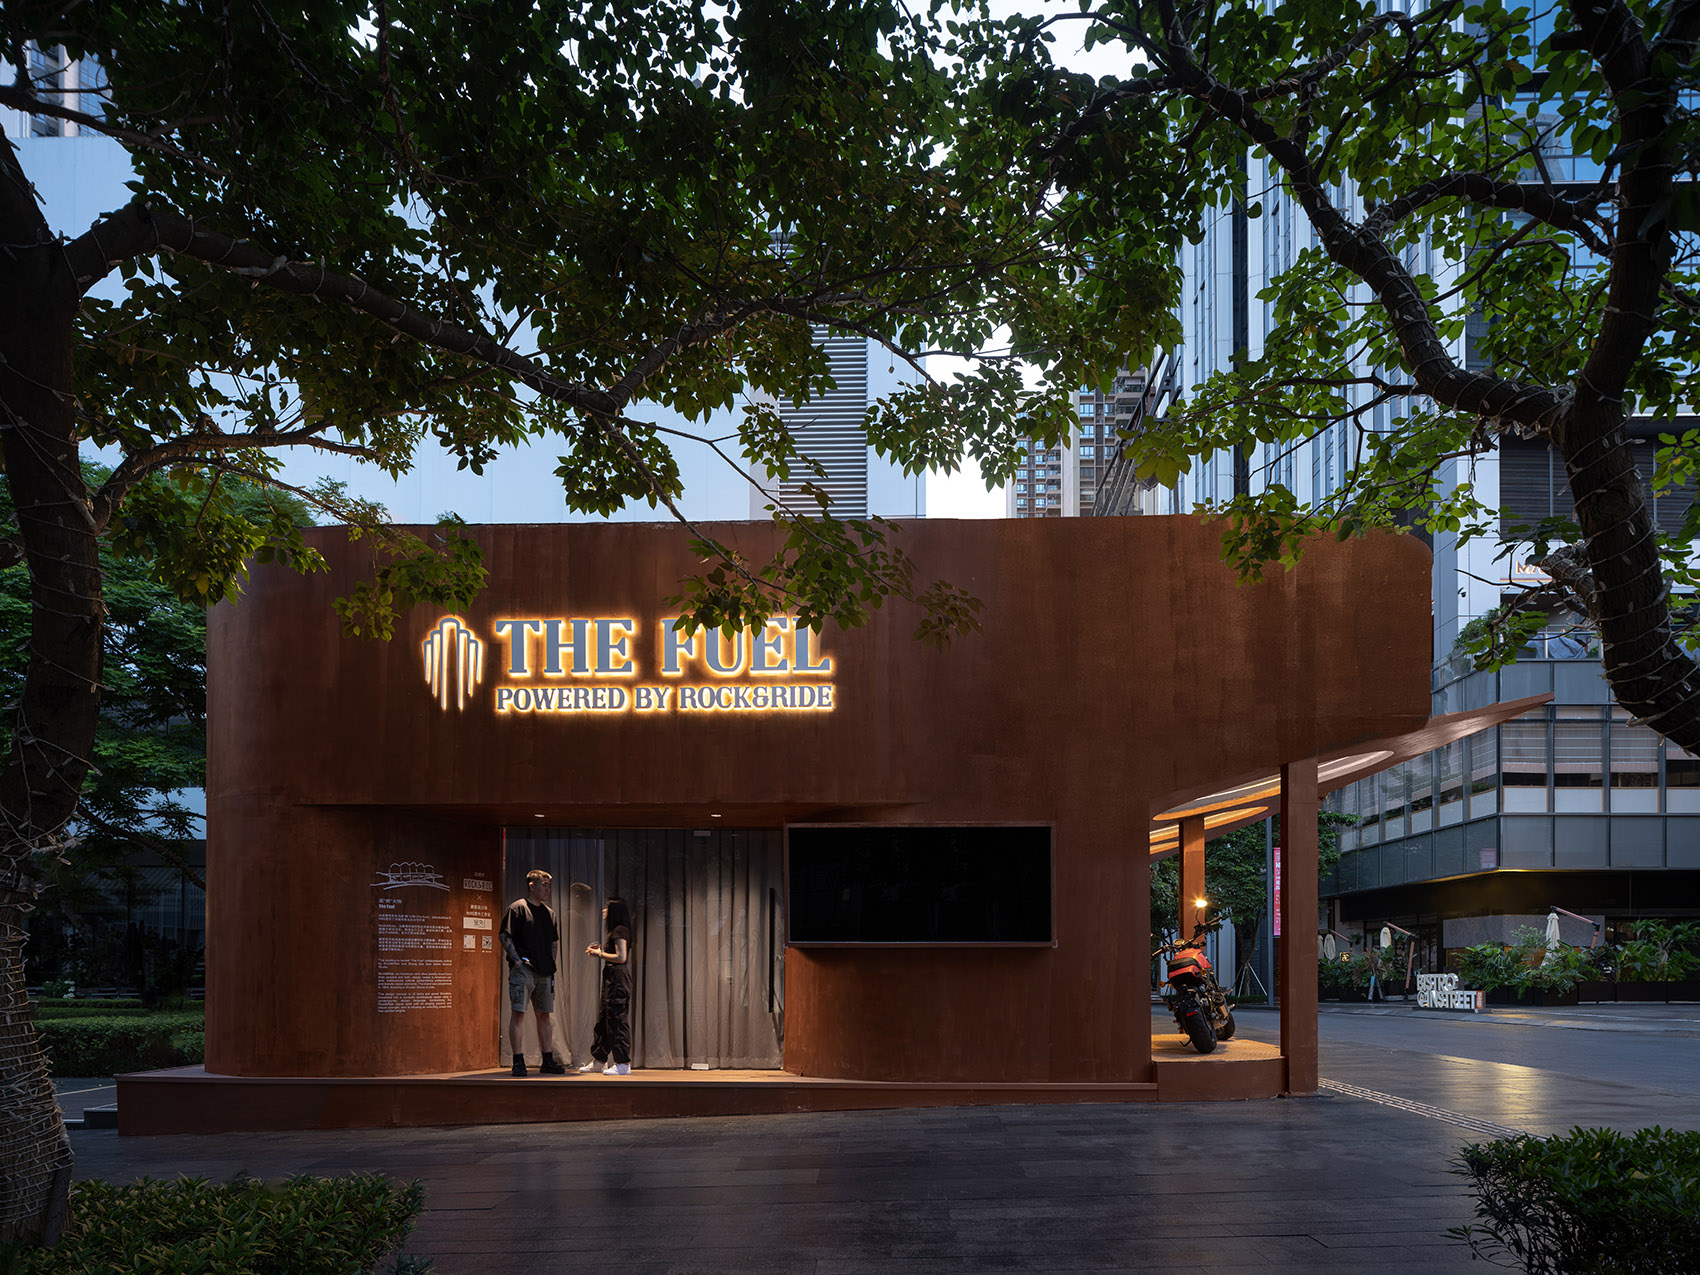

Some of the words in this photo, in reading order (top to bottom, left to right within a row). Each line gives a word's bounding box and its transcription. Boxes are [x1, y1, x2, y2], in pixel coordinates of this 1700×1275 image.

[496, 619, 634, 674] THE
[661, 617, 831, 673] FUEL
[496, 687, 625, 711] POWERED
[635, 686, 670, 709] BY
[679, 685, 832, 709] ROCK&RIDE
[1417, 973, 1459, 992] BISTRO
[1417, 990, 1477, 1010] @INSTREET
